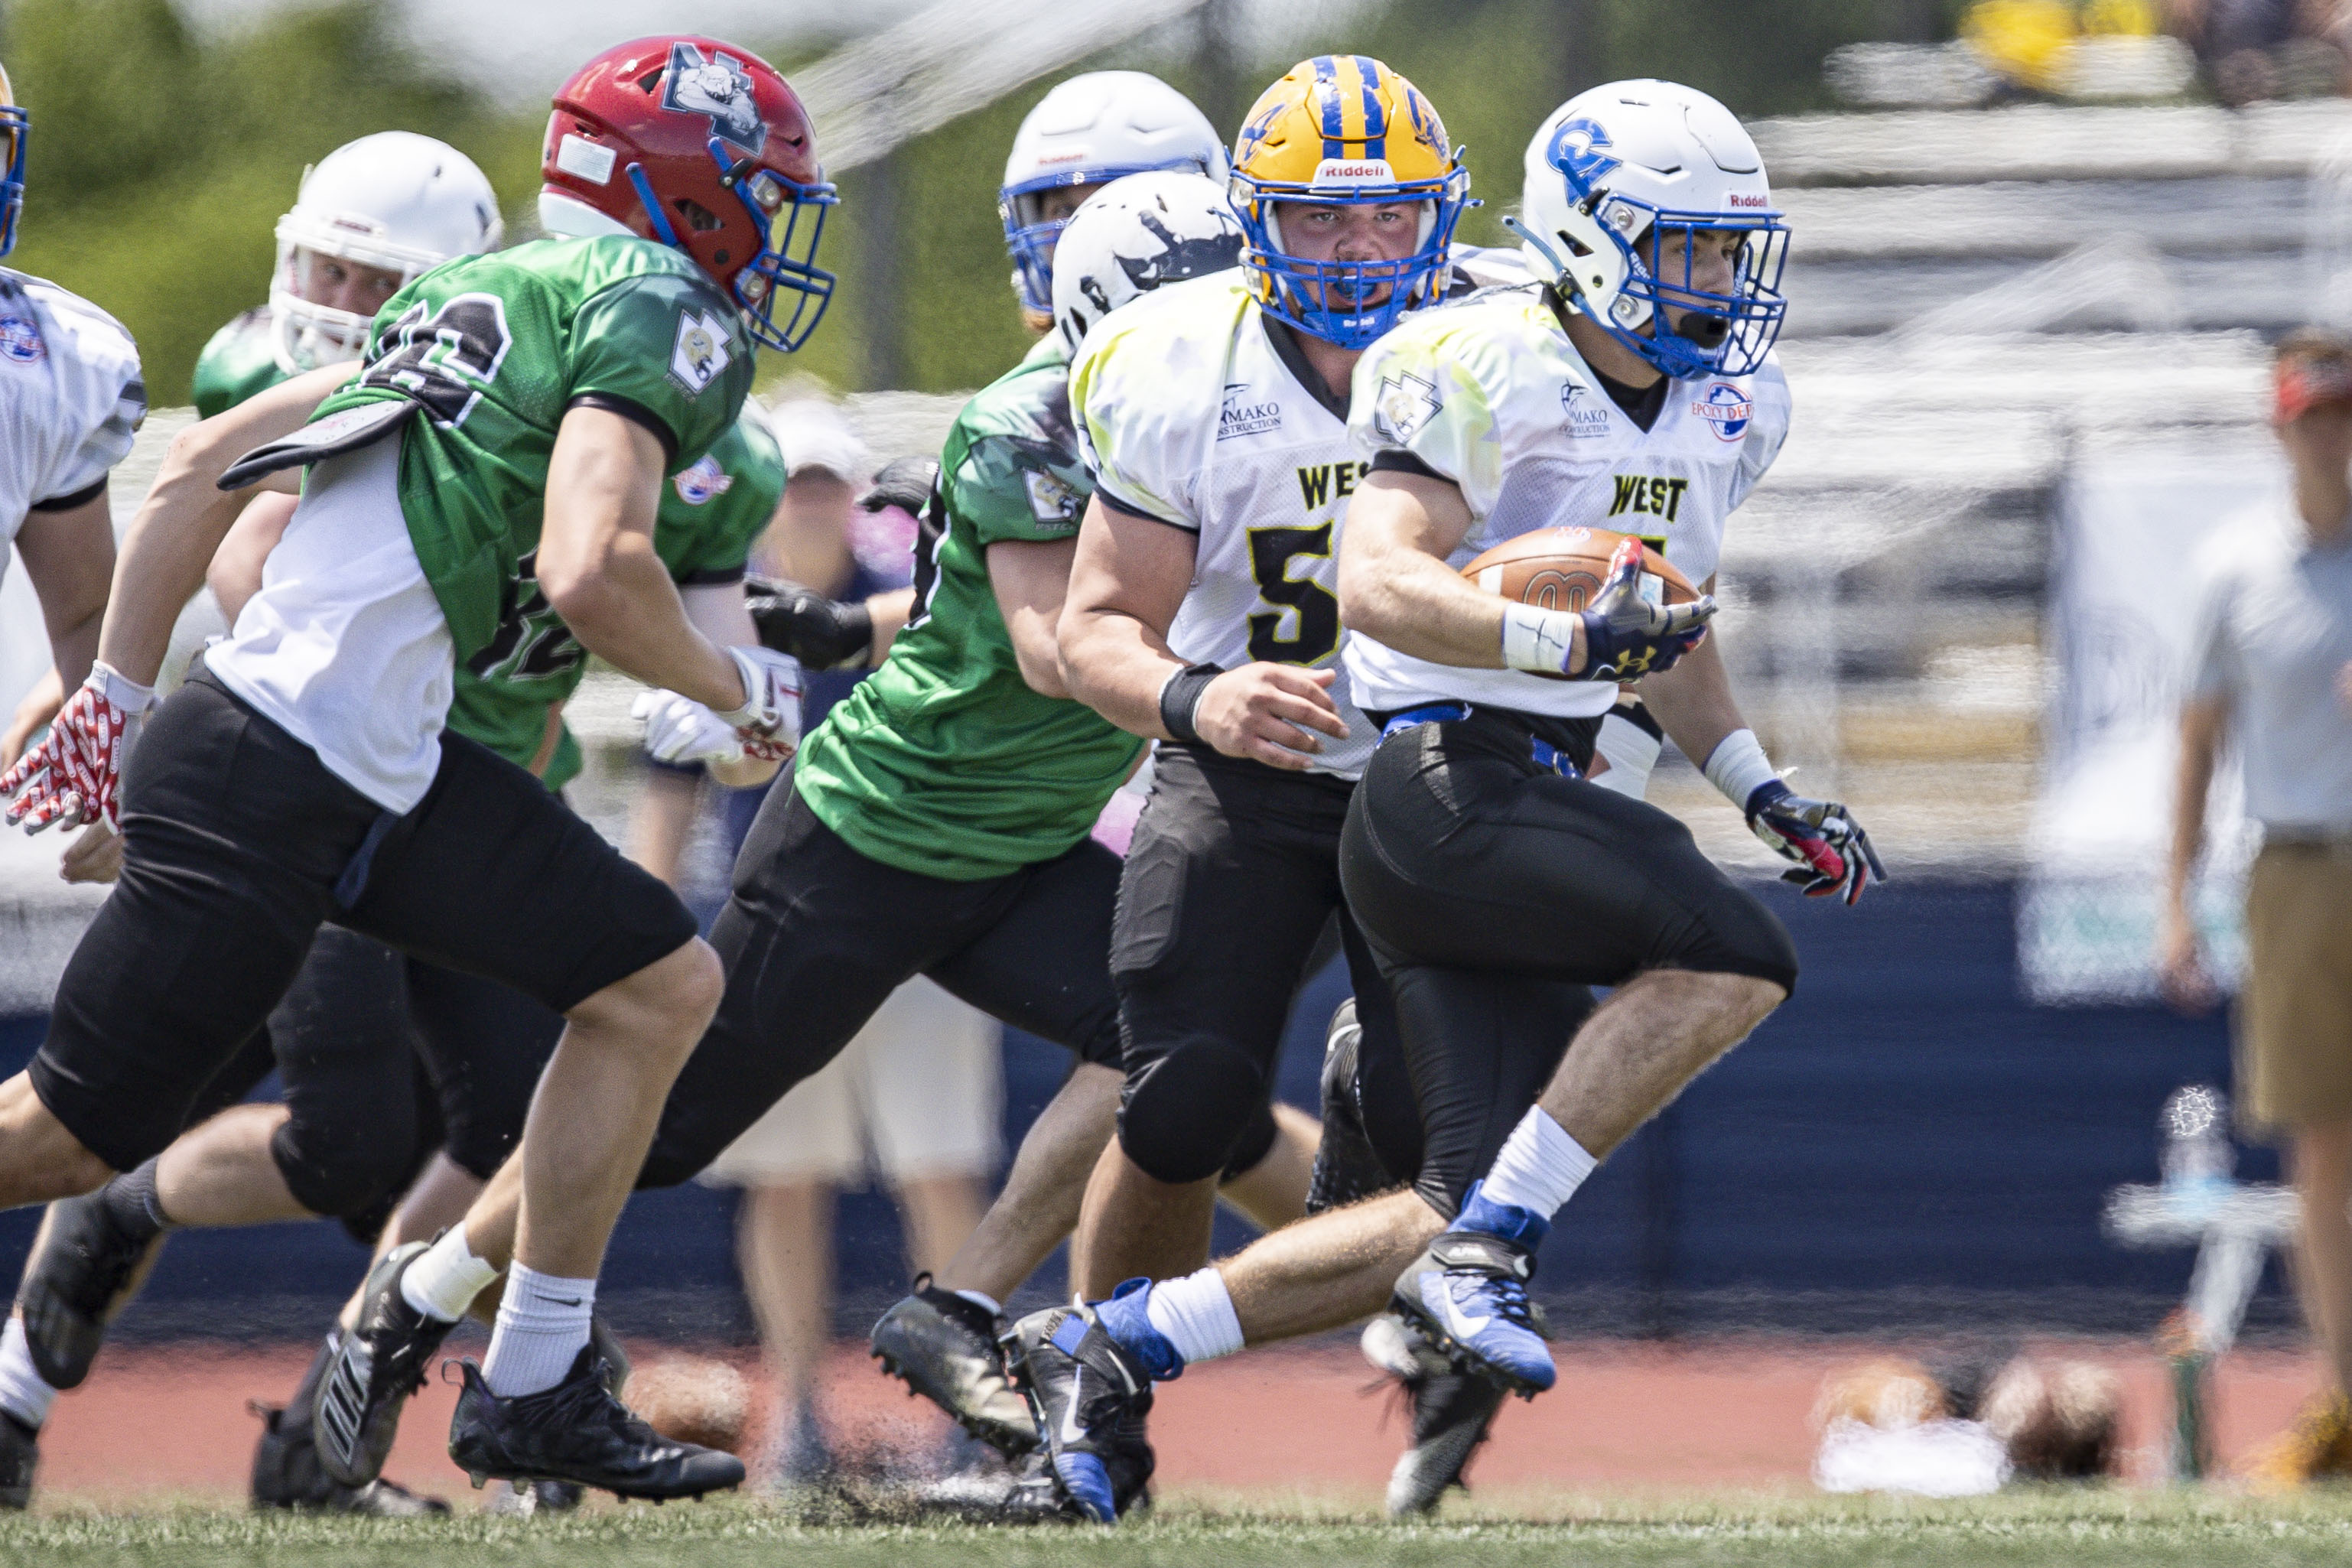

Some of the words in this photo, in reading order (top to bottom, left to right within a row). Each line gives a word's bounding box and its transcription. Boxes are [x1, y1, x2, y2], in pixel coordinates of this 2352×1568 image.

[1326, 166, 1384, 177] Riddell
[1730, 194, 1768, 207] Riddell
[1229, 402, 1280, 423] MAKO
[1572, 409, 1608, 423] MAKO
[1218, 417, 1282, 437] NSTRUCTION
[1298, 461, 1369, 512] WE
[1609, 474, 1688, 523] WEST
